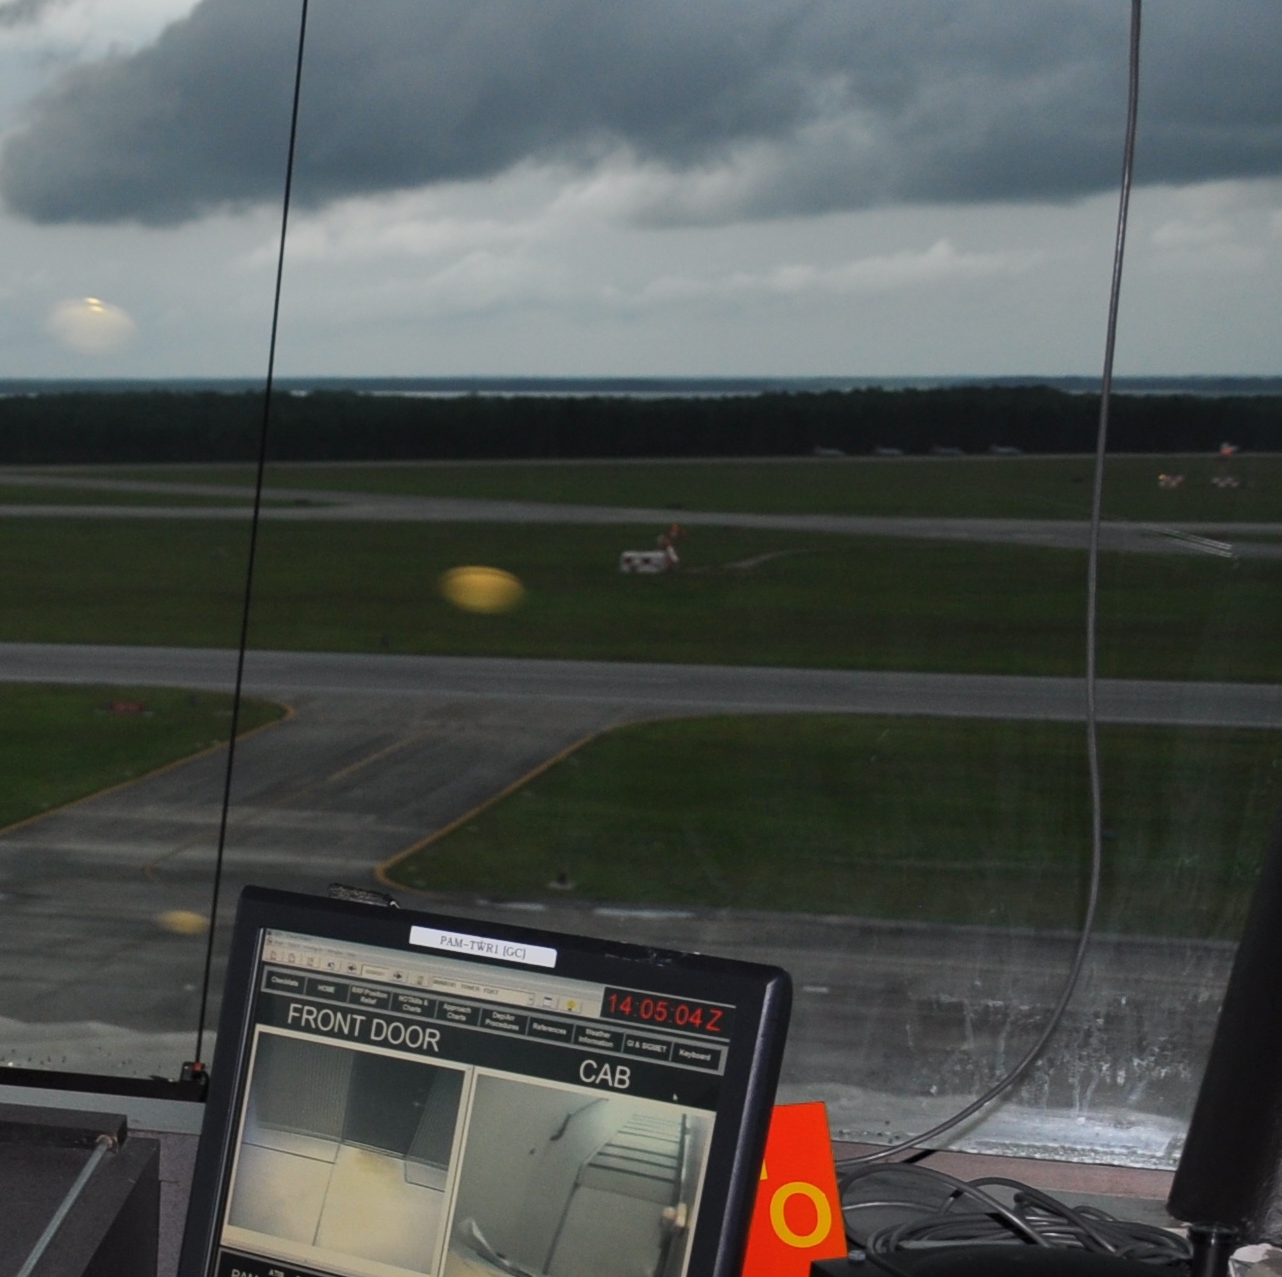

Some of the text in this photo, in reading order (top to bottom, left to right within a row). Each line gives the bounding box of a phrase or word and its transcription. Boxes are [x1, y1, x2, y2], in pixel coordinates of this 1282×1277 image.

[287, 1002, 441, 1052] FRONT DOOR
[579, 1059, 631, 1089] CAB
